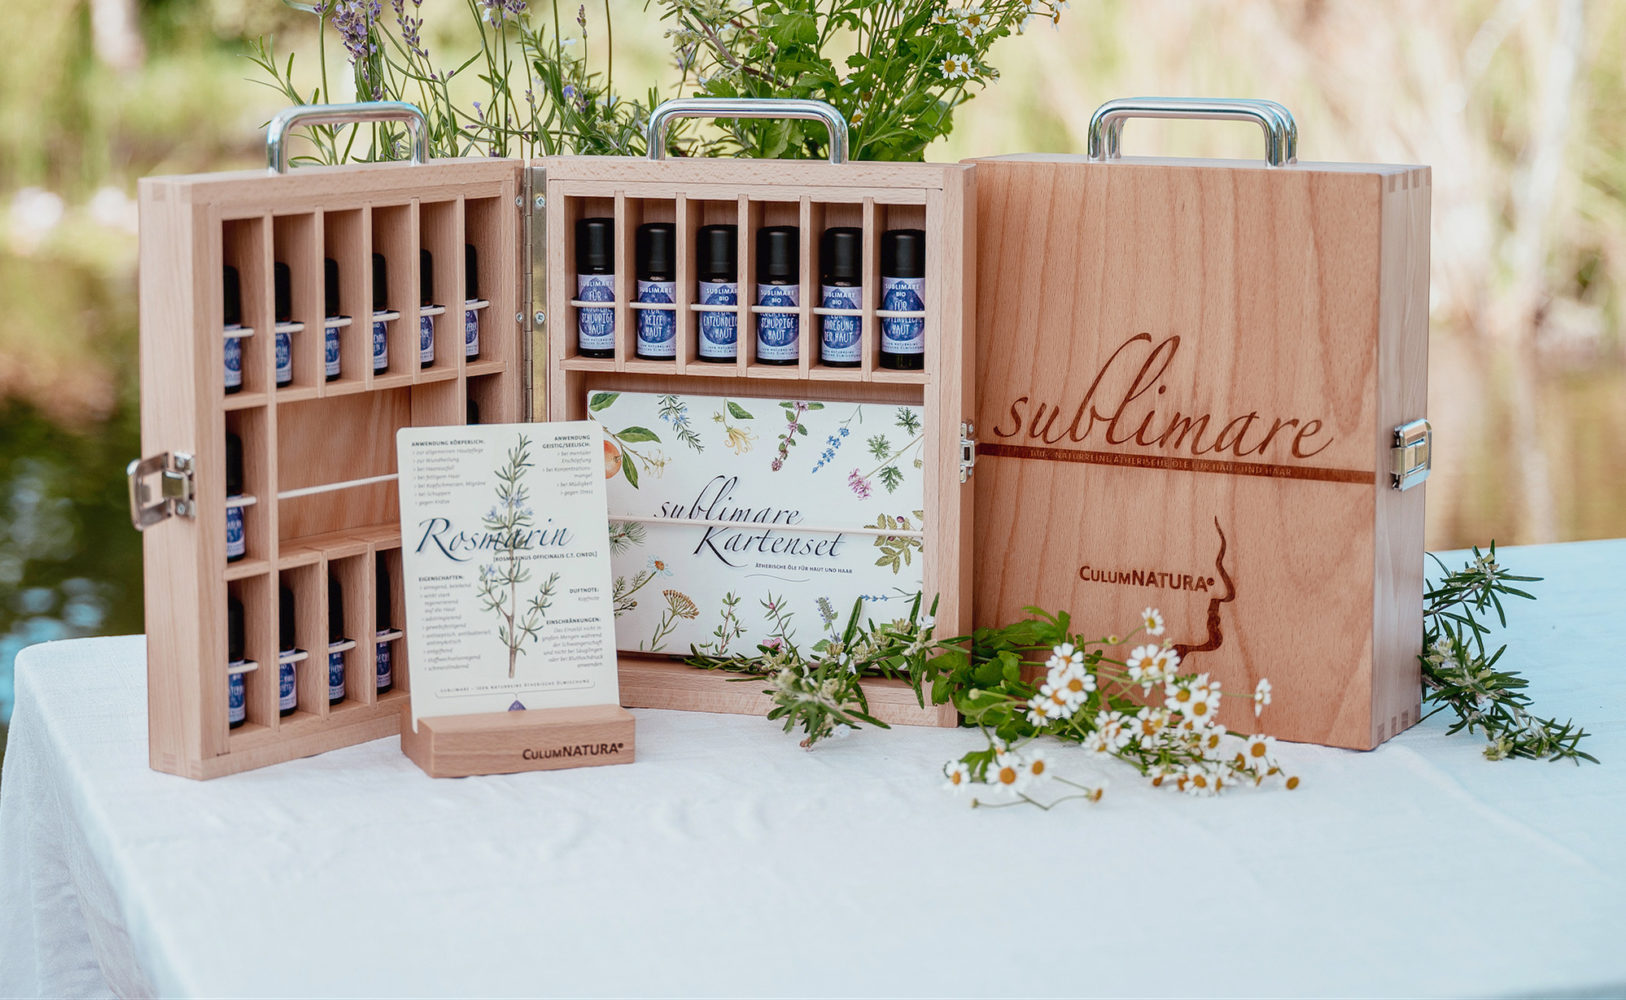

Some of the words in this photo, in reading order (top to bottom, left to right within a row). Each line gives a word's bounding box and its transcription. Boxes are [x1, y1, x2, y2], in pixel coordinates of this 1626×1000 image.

[582, 312, 613, 324] SCHUPPIGE
[645, 315, 663, 326] REIFE
[761, 318, 794, 329] SCHUPPIGE
[589, 324, 605, 335] HAUT
[645, 327, 663, 338] HAUT
[715, 327, 733, 338] HAUT
[768, 330, 786, 340] HAUT
[892, 325, 910, 336] HAUT
[834, 332, 853, 343] HAUT
[993, 332, 1334, 458] sublimare
[653, 474, 804, 525] sublimare
[415, 517, 574, 562] Rosmarin
[693, 526, 846, 567] Kartenset
[755, 562, 786, 570] ÄTHERISCHE
